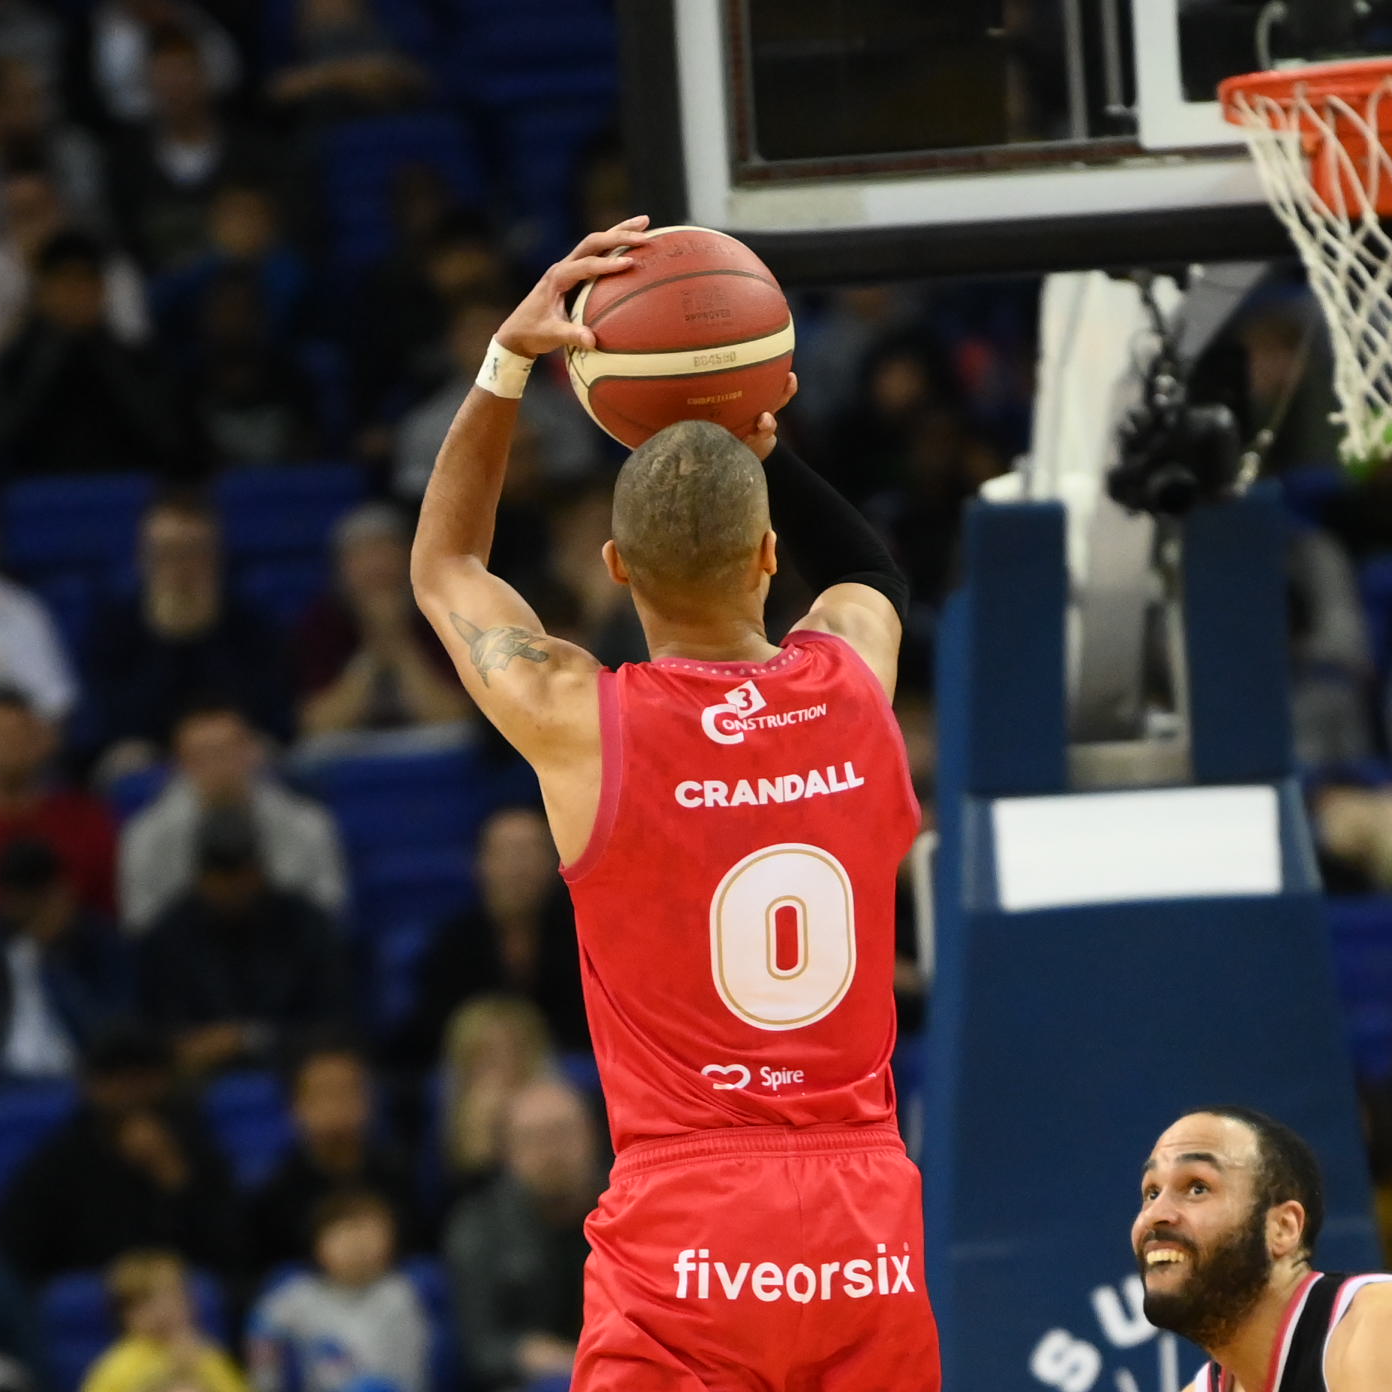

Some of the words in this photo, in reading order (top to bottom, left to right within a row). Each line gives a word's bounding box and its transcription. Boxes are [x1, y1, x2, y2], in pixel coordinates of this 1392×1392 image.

[674, 761, 865, 808] CRANDALL
[710, 842, 857, 1031] 0
[760, 1066, 805, 1091] Spire
[673, 1242, 915, 1304] fiveorsix
